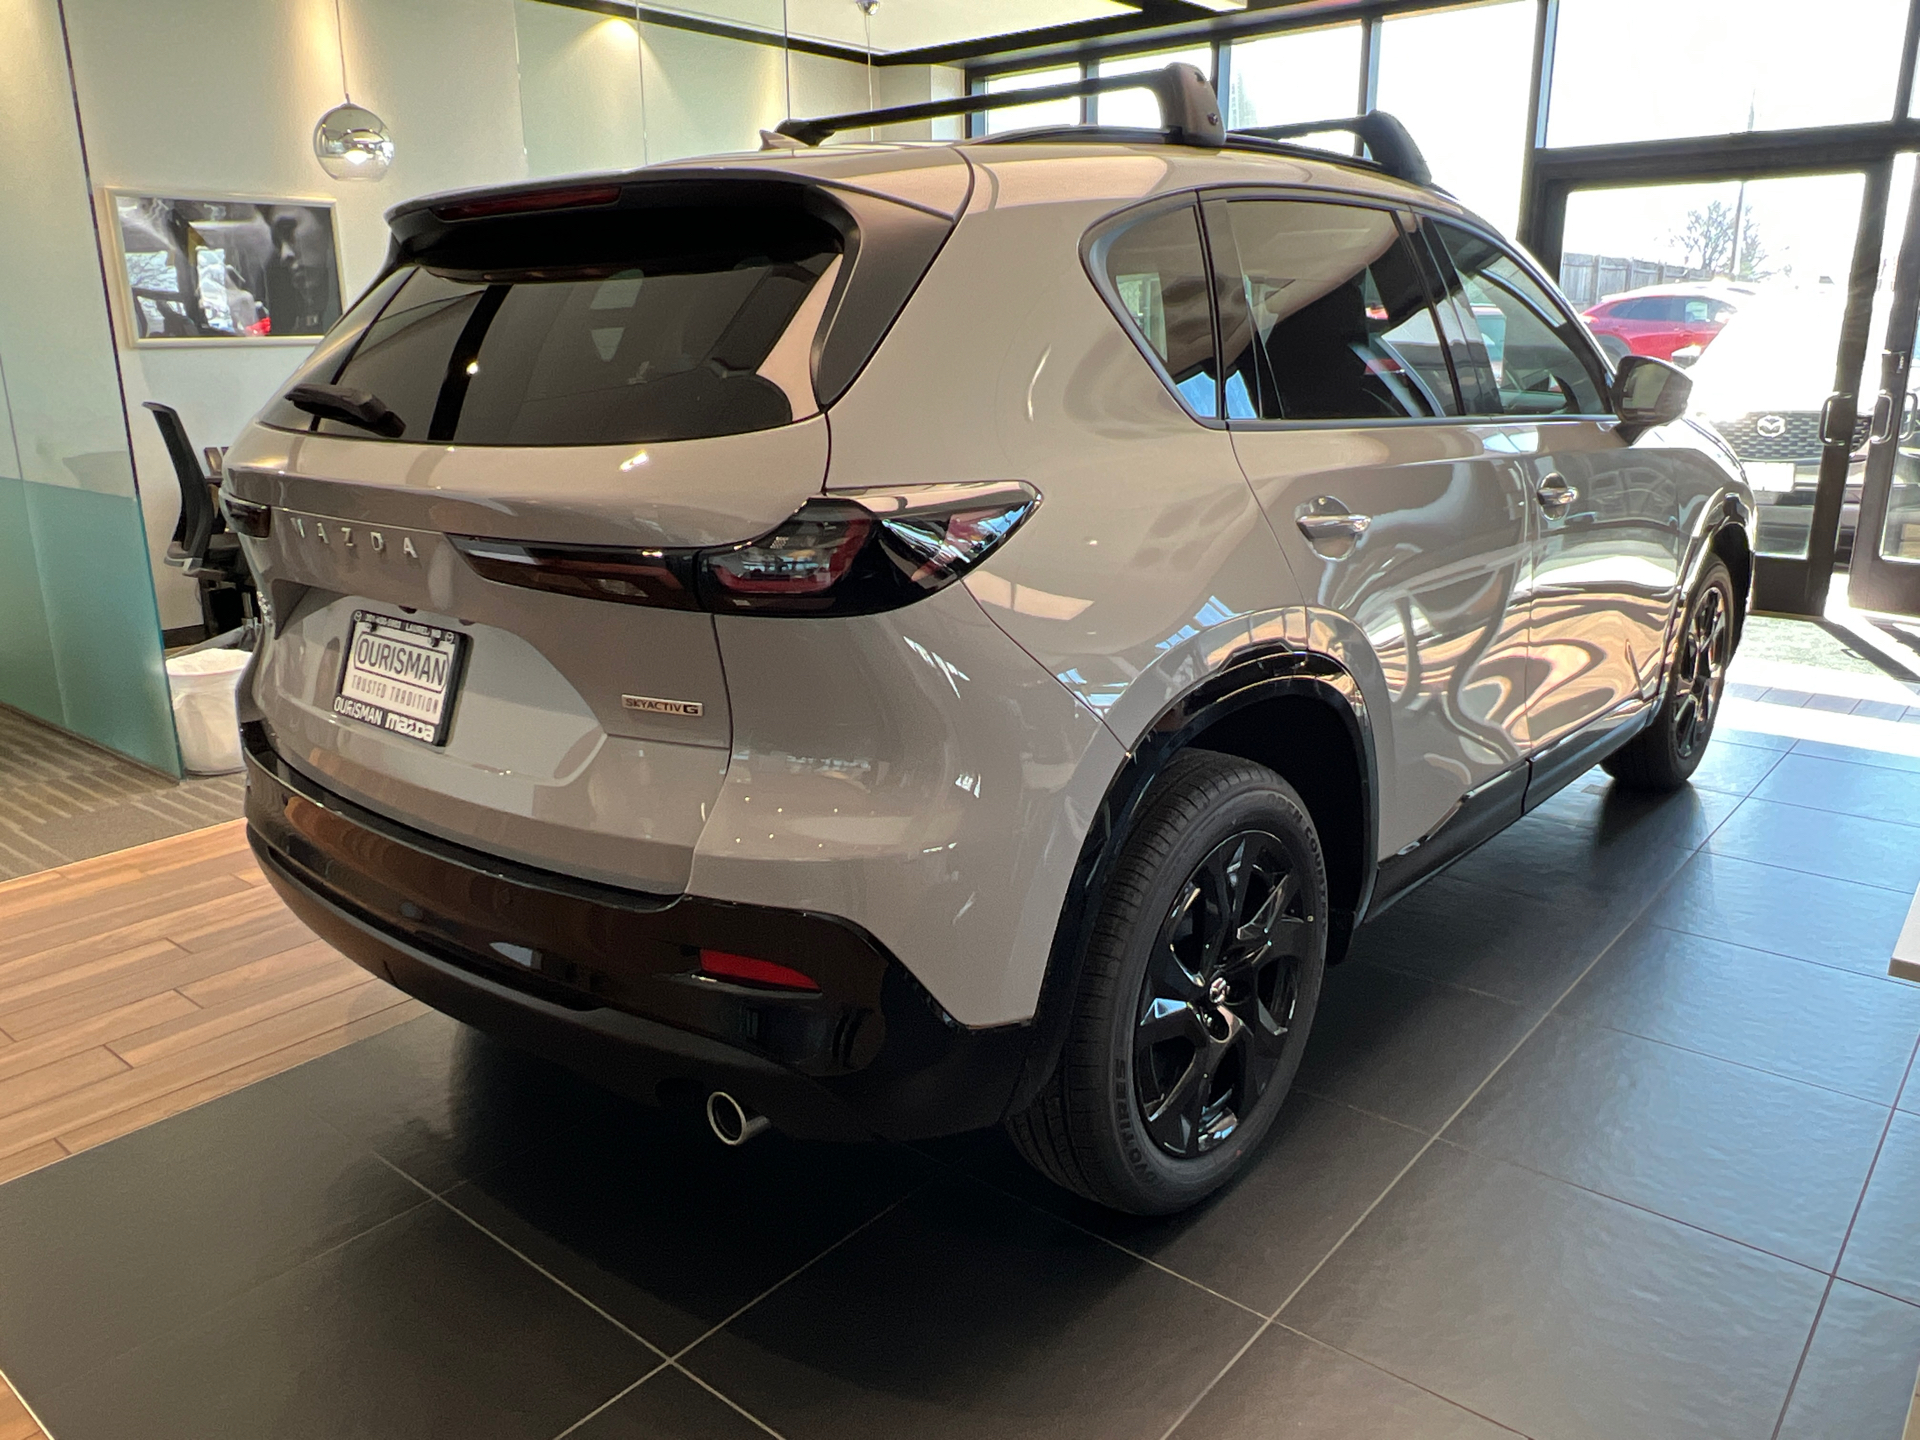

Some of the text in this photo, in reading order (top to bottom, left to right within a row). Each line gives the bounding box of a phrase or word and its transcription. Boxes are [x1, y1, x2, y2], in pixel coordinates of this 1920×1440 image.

[290, 517, 419, 559] MAZDA
[357, 638, 447, 686] OURISMAN
[334, 696, 383, 726] OURISMAN
[351, 674, 440, 715] TRUSTED TRADITION
